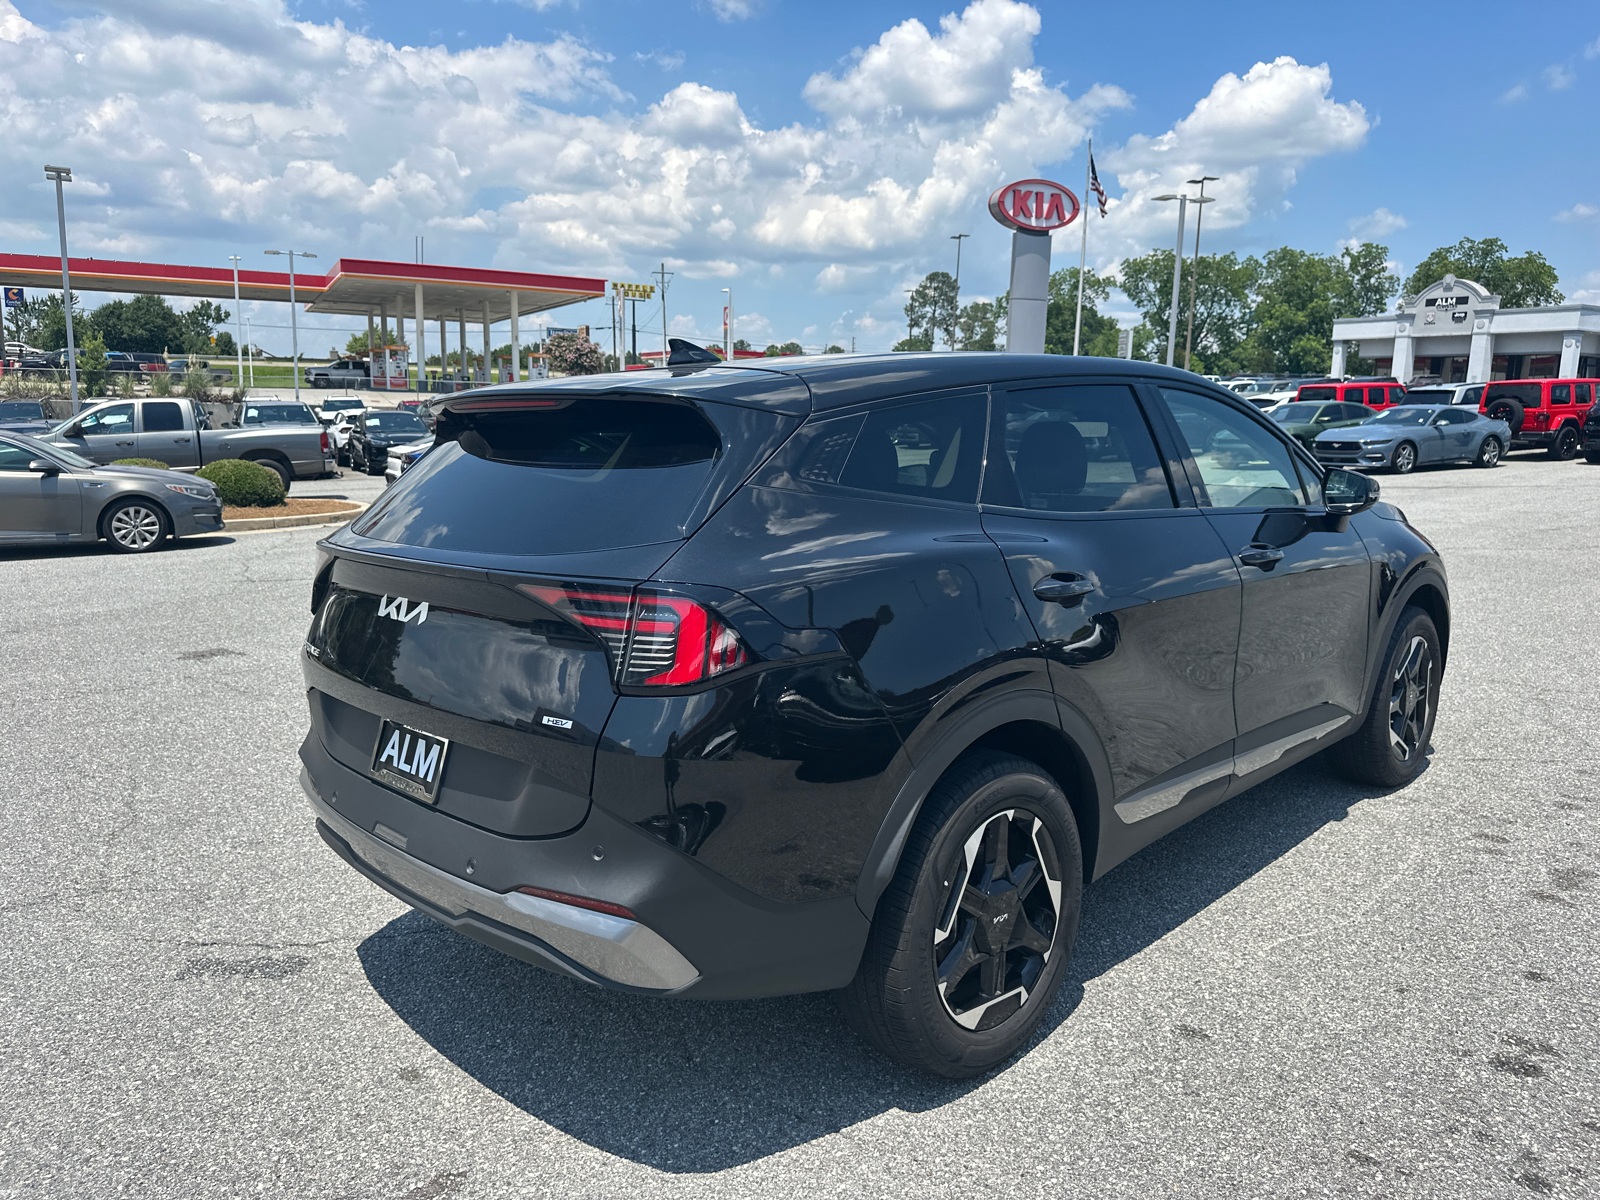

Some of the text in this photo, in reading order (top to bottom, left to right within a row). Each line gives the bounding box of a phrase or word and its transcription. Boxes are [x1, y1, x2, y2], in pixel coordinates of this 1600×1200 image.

[1013, 189, 1065, 221] KIA
[612, 282, 655, 292] WAFFLE
[1435, 297, 1456, 305] ALM
[546, 717, 569, 727] HEV
[380, 729, 441, 783] ALM
